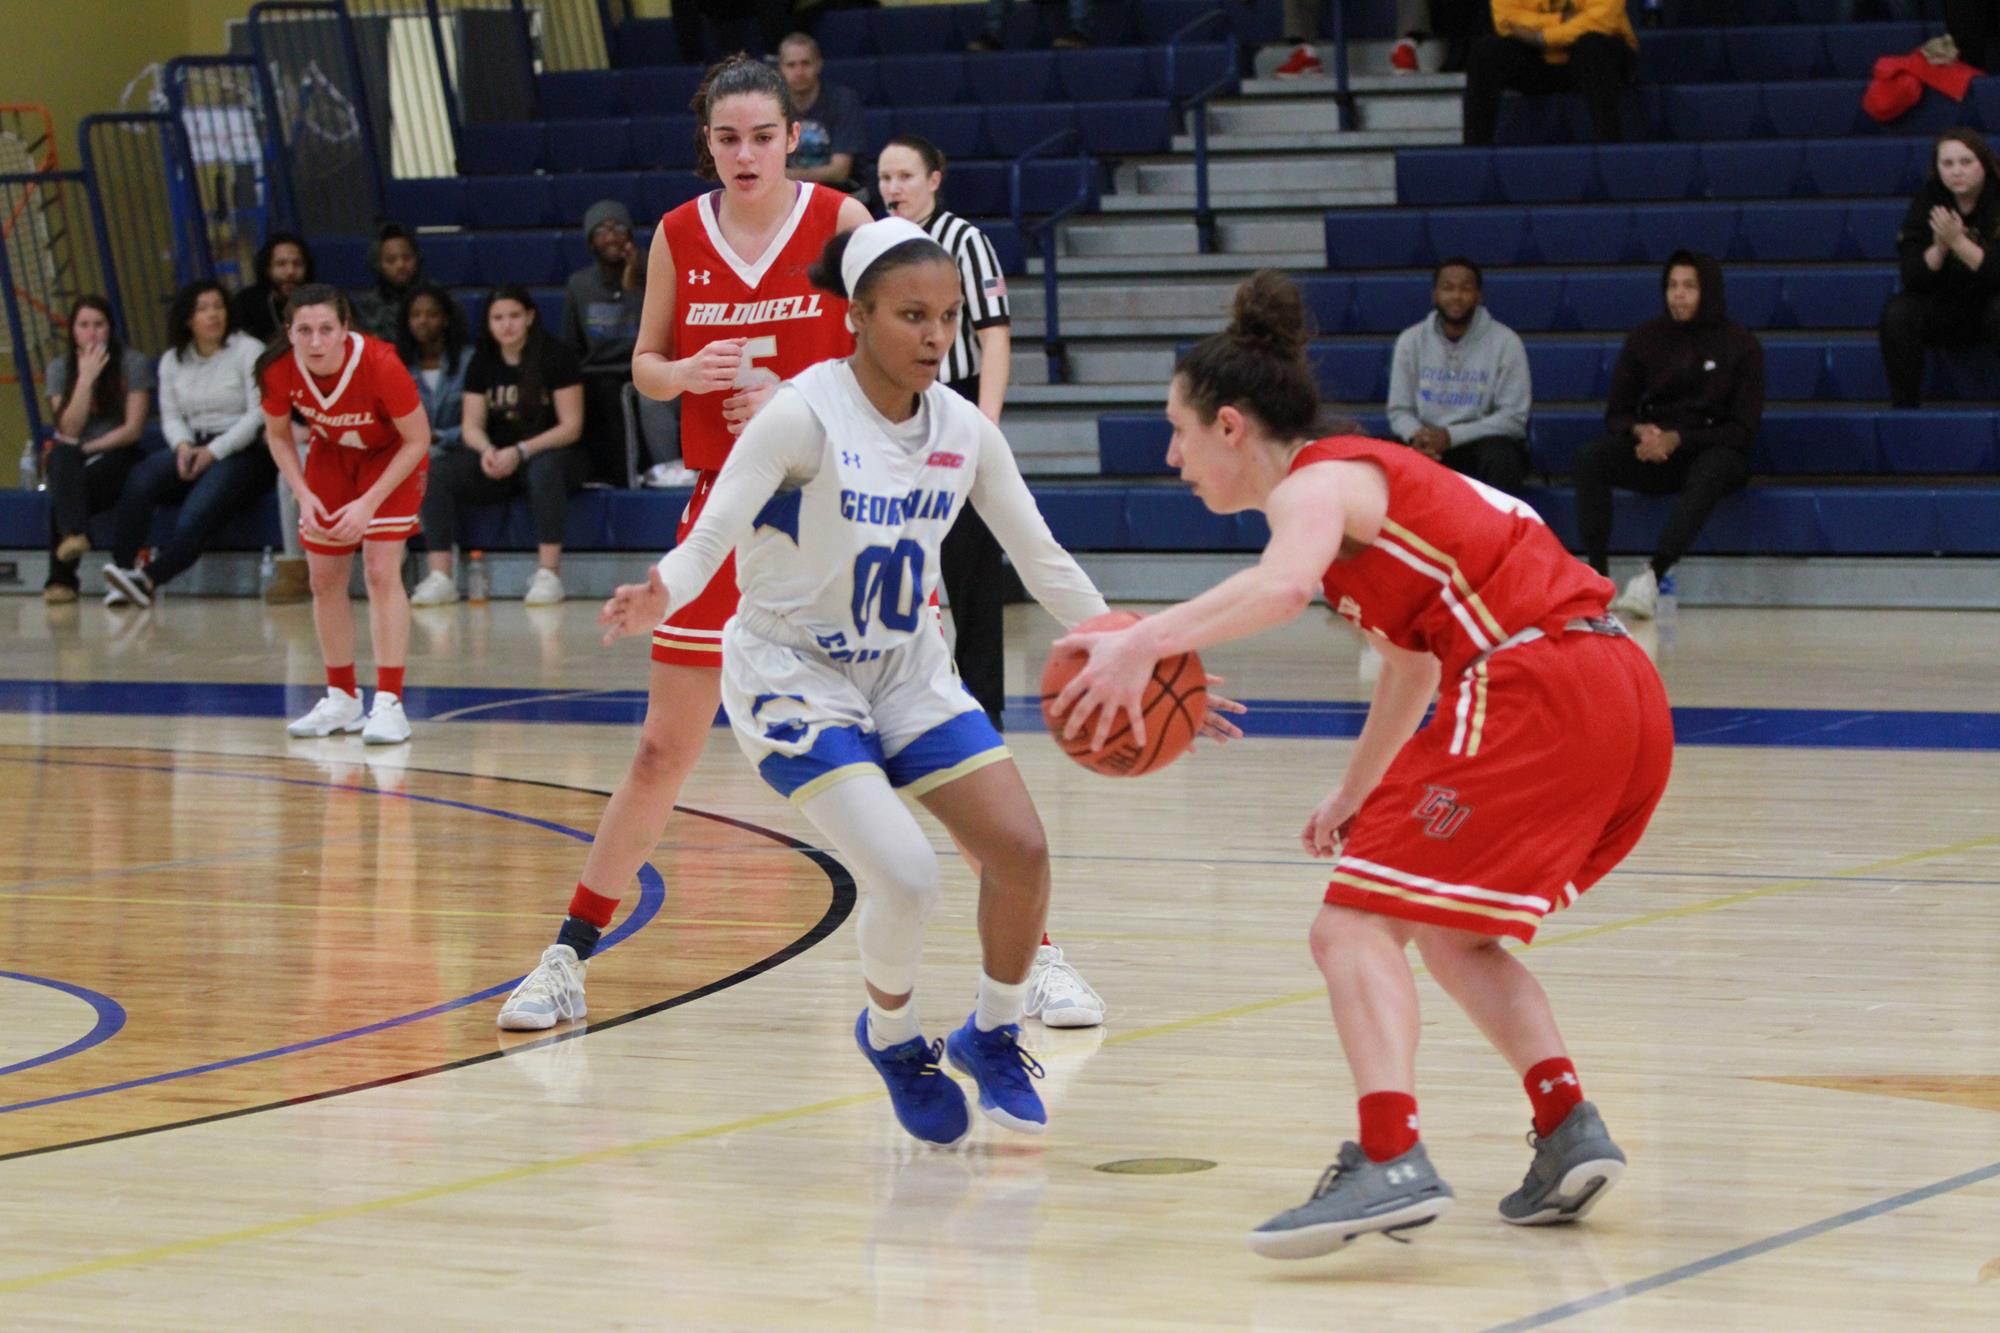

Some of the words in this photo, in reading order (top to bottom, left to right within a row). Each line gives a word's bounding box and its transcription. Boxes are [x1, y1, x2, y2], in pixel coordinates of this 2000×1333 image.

[685, 294, 823, 326] CALDWELL
[732, 334, 781, 390] 5
[851, 538, 925, 637] 00
